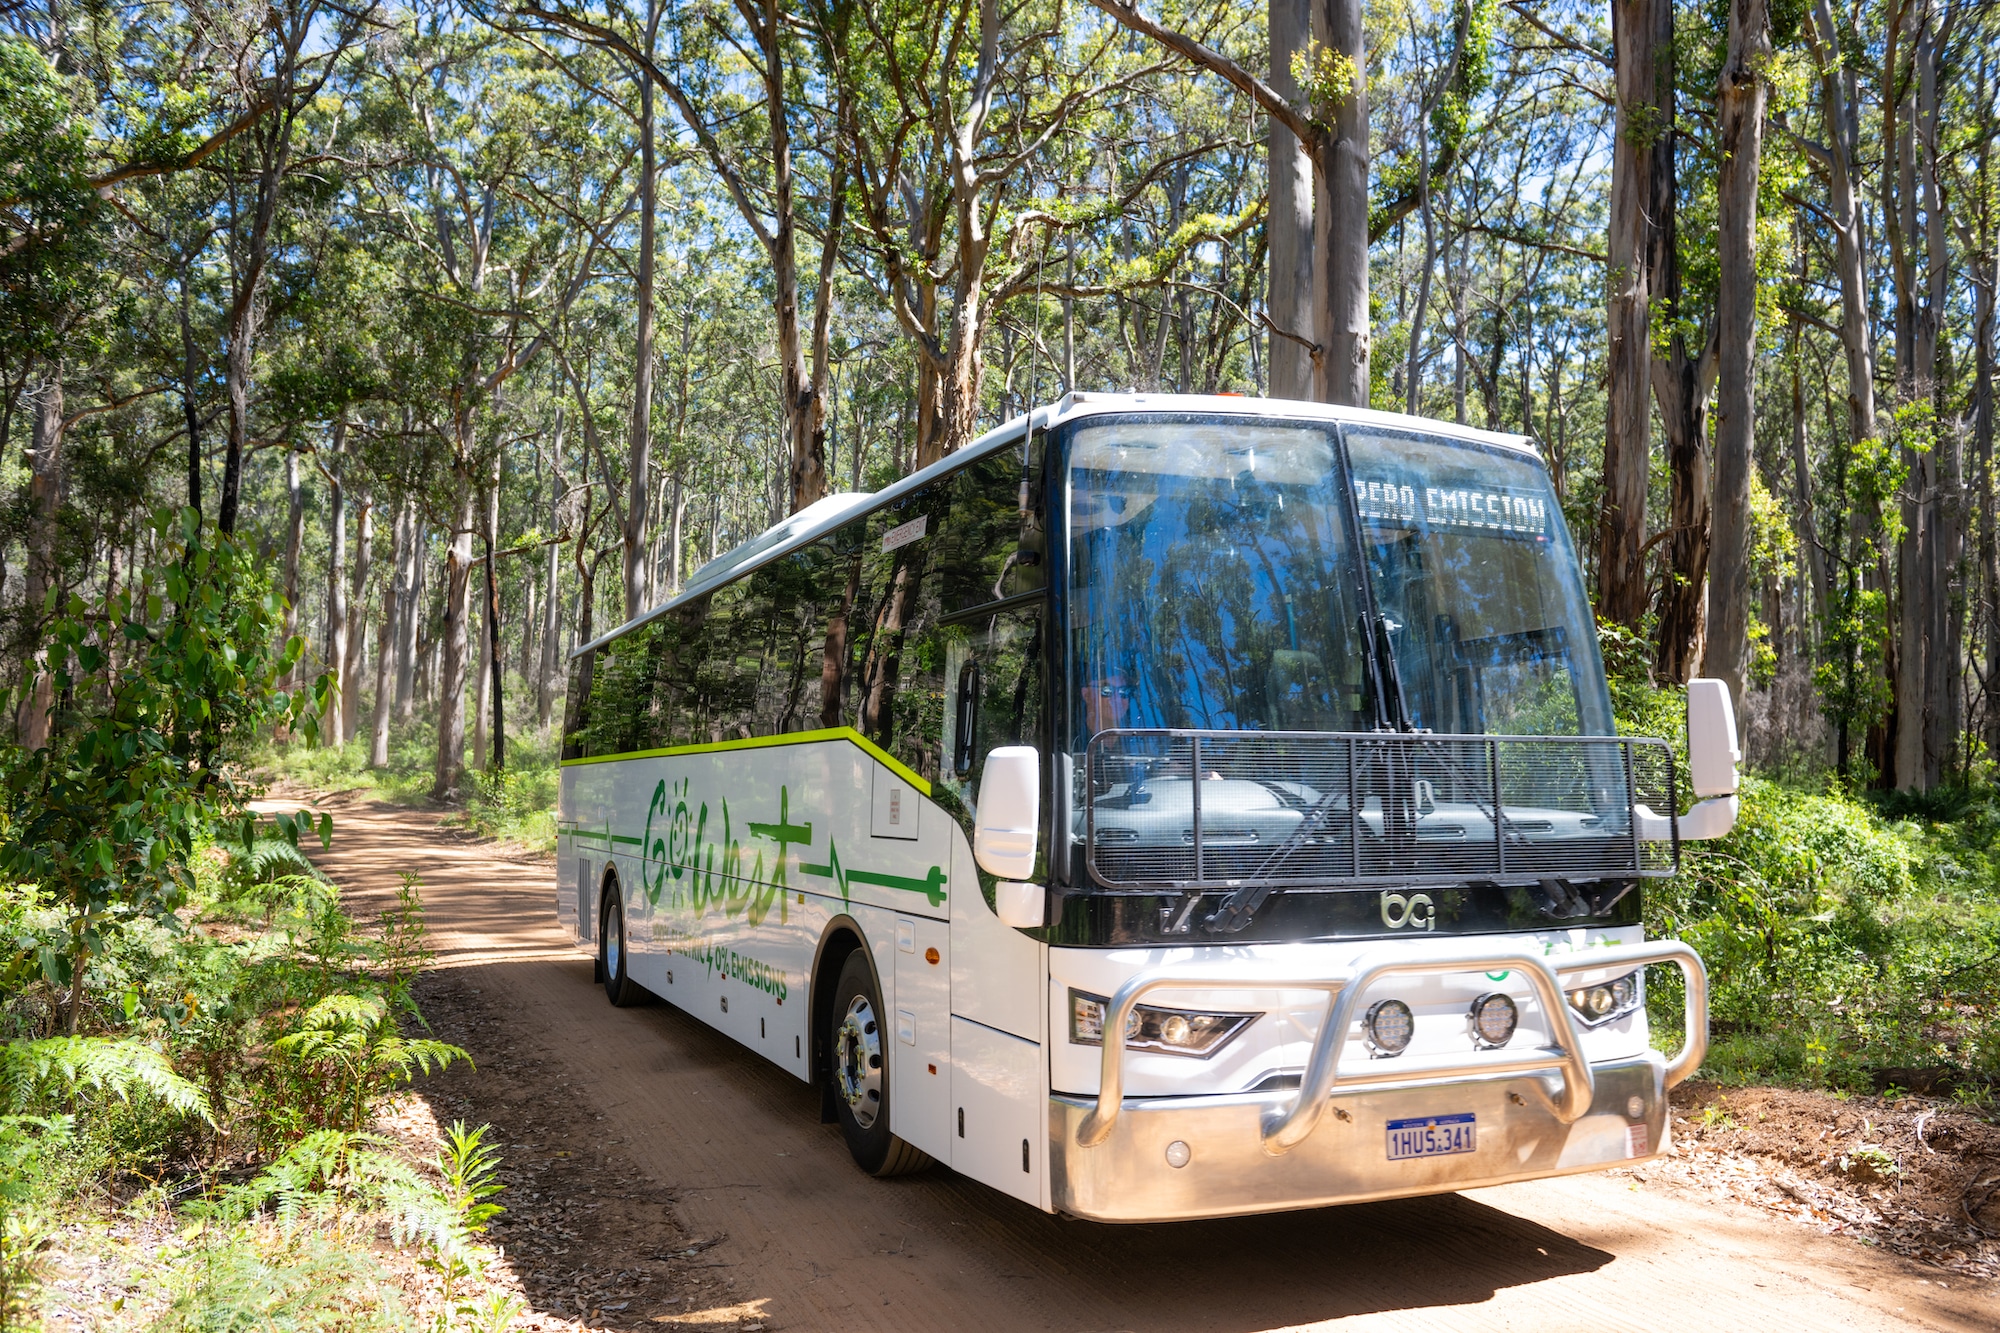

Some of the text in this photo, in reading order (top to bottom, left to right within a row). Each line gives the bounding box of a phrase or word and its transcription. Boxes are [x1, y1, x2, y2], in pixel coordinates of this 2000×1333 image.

[1354, 480, 1545, 533] ZERO EMISSION
[731, 951, 787, 1001] EMISSIONS
